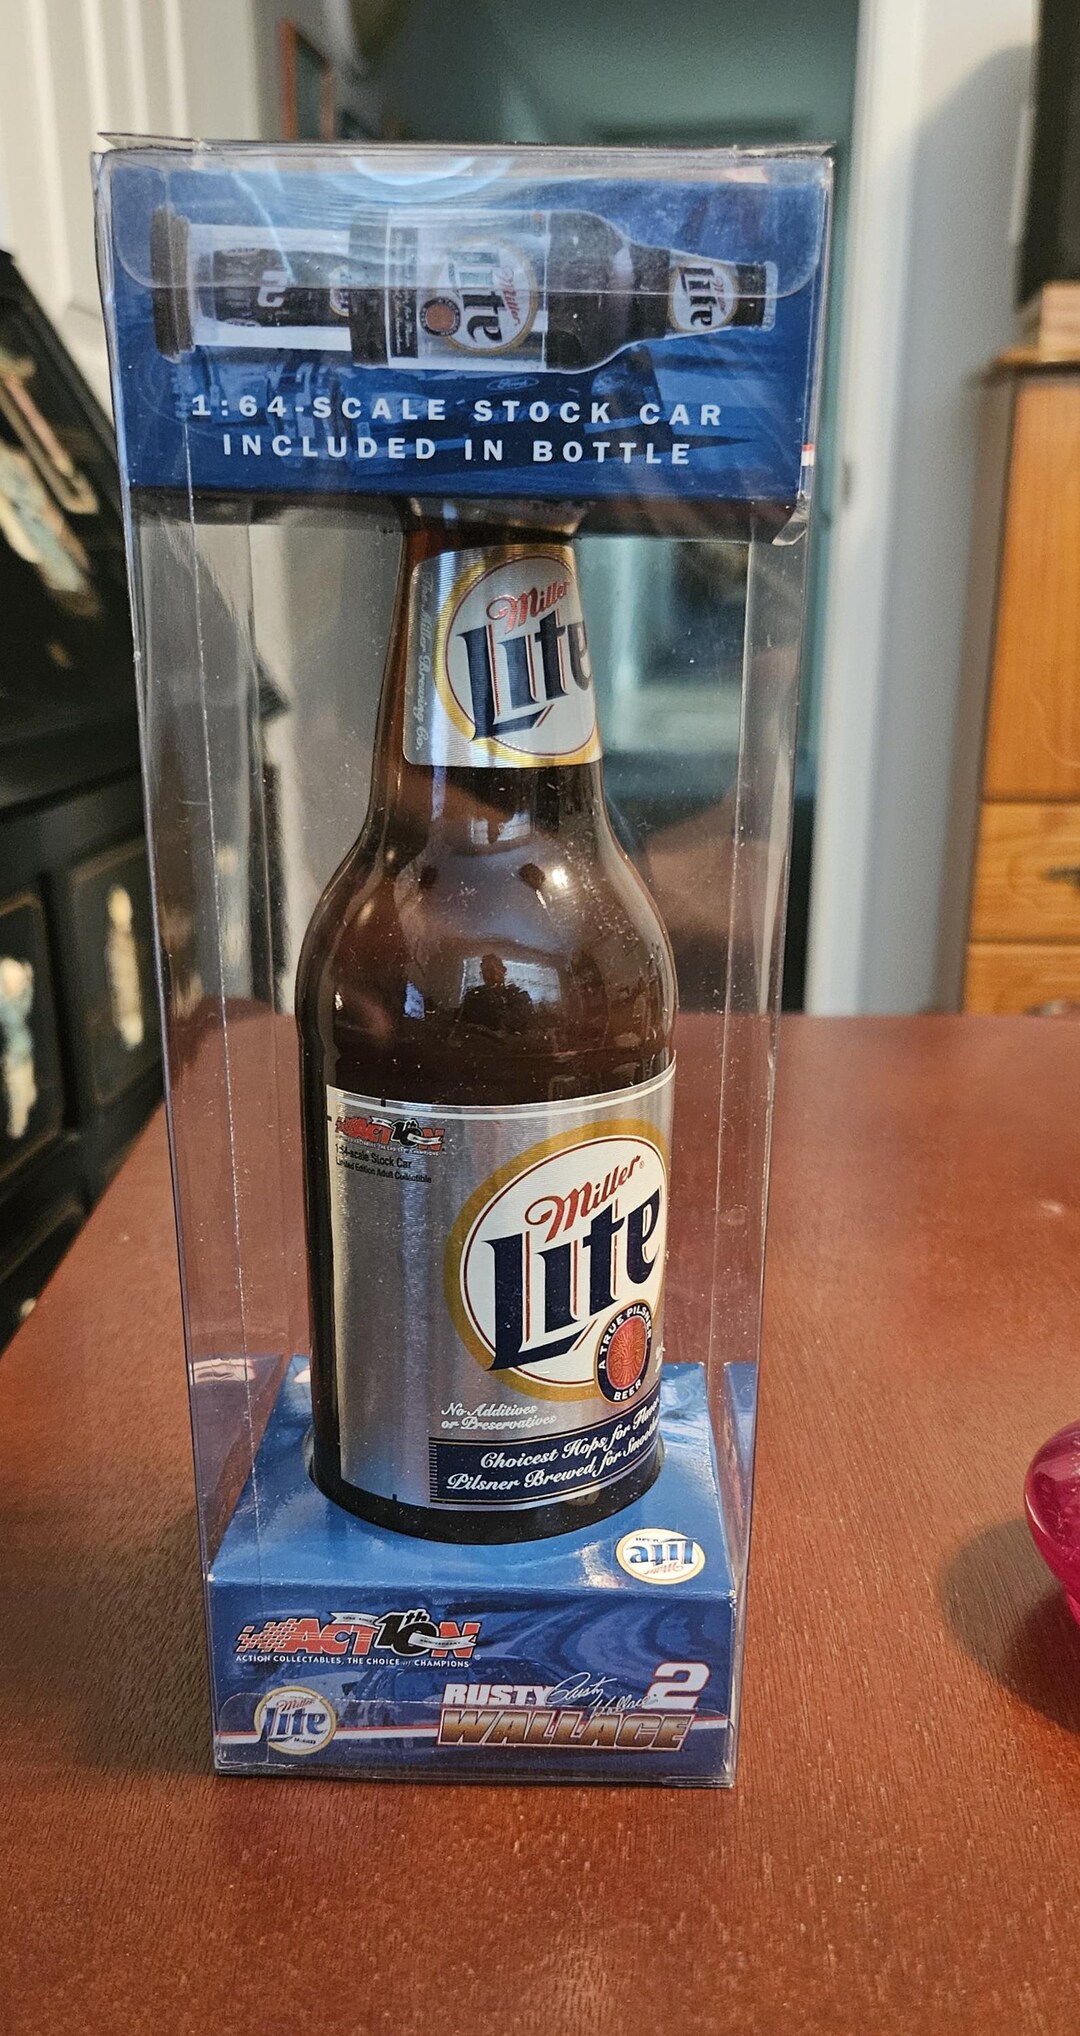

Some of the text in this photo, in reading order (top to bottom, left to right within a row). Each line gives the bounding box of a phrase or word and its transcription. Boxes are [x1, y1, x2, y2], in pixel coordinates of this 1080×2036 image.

[447, 252, 508, 342] Lite
[679, 267, 717, 326] Lite
[192, 395, 722, 427] 1:64-SCALE STOCK CAR
[223, 434, 690, 465] INCLUDED IN BOTTLE
[419, 604, 433, 653] Miller
[486, 580, 570, 634] Miller
[413, 655, 430, 723] Brewing
[456, 609, 592, 741] Lite
[415, 726, 429, 751] Co.
[371, 1153, 396, 1167] Stock
[396, 1158, 412, 1169] Car
[525, 1155, 640, 1243] Miller
[481, 1185, 661, 1371] Lite
[600, 1315, 624, 1355] TRUE
[627, 1305, 651, 1339] PILSNER
[441, 1403, 538, 1417] No Additives
[614, 1379, 641, 1400] BEER
[441, 1415, 557, 1430] or Preservatives
[480, 1448, 559, 1468] Choicest
[562, 1437, 606, 1459] Hops
[604, 1425, 630, 1449] for
[447, 1473, 520, 1491] Pilsner
[524, 1460, 595, 1488] Brewed
[592, 1451, 622, 1477] for
[627, 1538, 697, 1565] Lite
[273, 1655, 344, 1664] COLLECTABLES,
[414, 1659, 470, 1668] CHAMPIONS
[445, 1683, 553, 1706] RUSTY
[644, 1661, 711, 1710] 2
[259, 1707, 327, 1742] Lite
[438, 1708, 695, 1751] WALLACE
